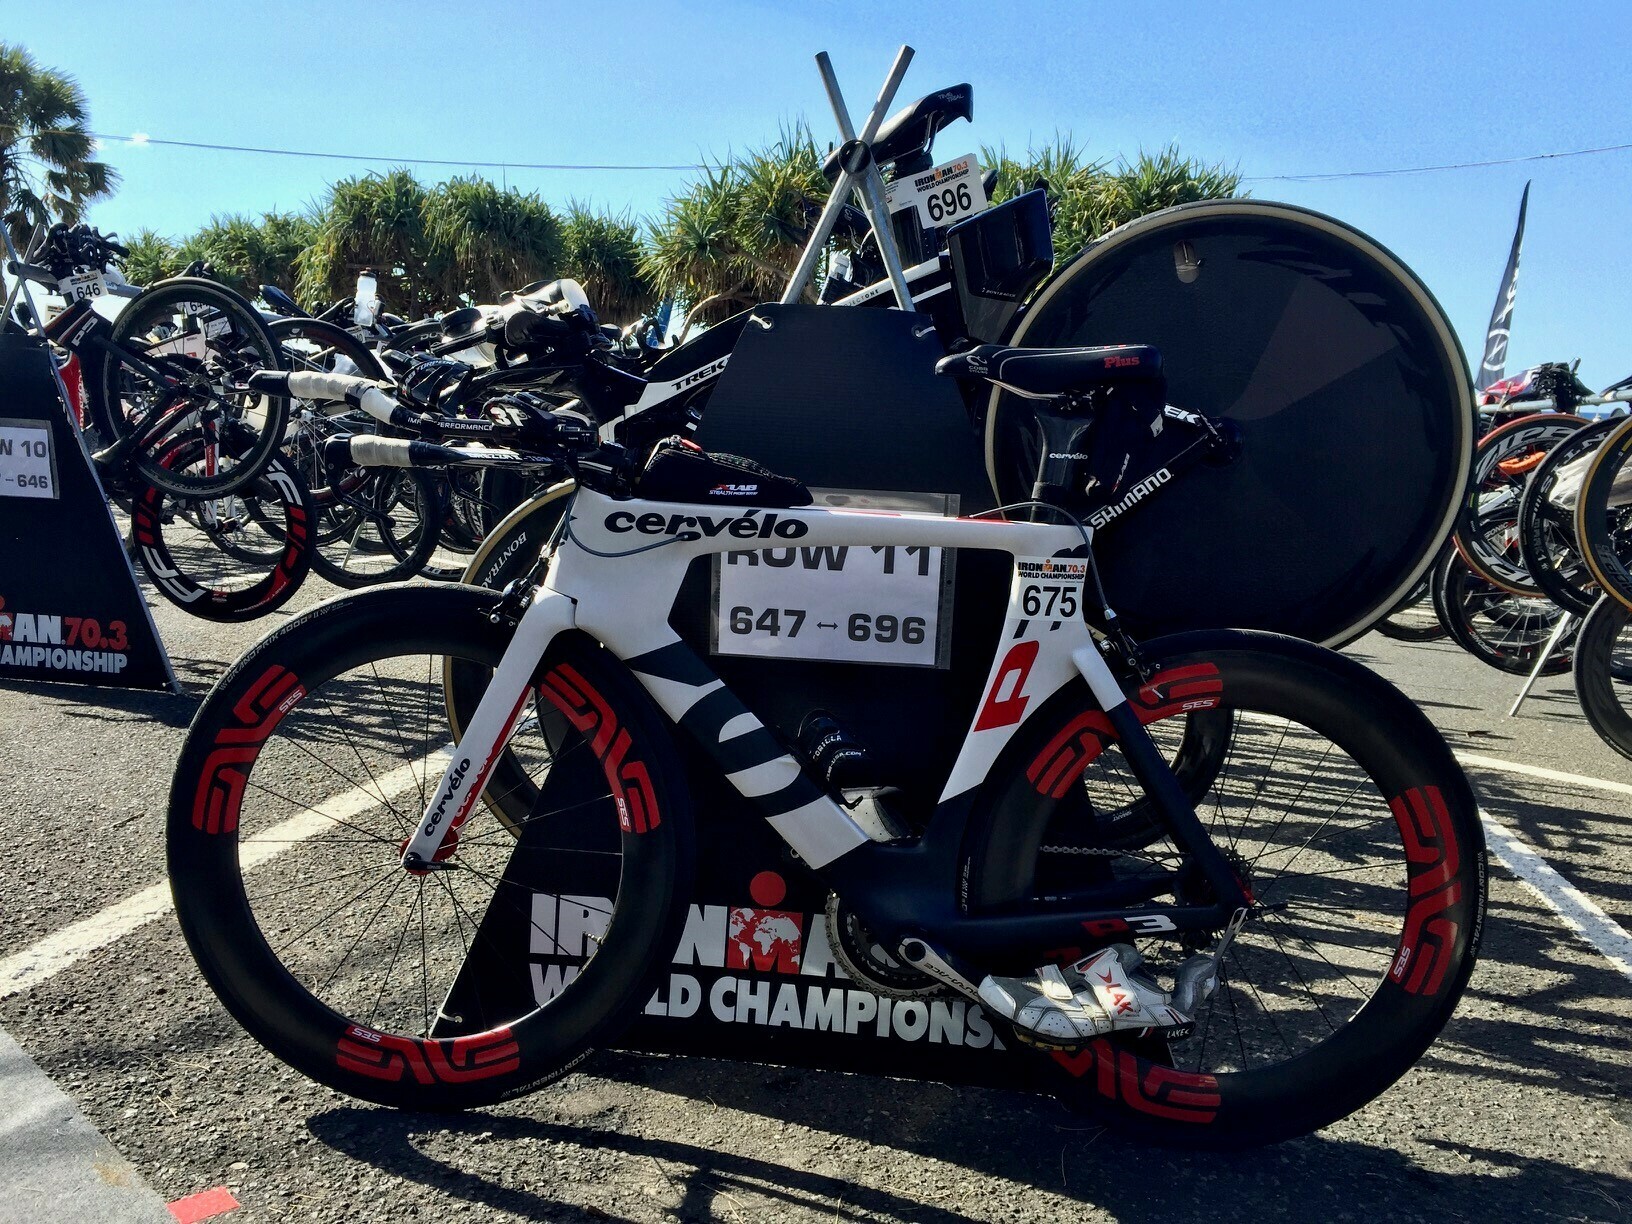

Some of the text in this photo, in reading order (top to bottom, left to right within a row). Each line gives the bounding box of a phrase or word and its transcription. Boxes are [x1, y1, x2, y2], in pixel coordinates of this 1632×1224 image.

[927, 182, 972, 222] 696
[76, 282, 101, 299] 646
[671, 357, 729, 391] TREK
[1104, 356, 1140, 368] Plus
[490, 405, 524, 427] 3T
[1163, 404, 1201, 424] EK
[21, 440, 47, 458] 10
[1048, 451, 1089, 460] cervélo
[17, 474, 48, 489] 646
[1090, 467, 1172, 530] SHIMANO
[604, 509, 808, 541] cervélo
[870, 545, 929, 576] 11
[1017, 560, 1086, 574] IRONMAN 70.3
[1017, 570, 1085, 580] WORLD CHAMPIONSHIP
[1022, 584, 1078, 618] 675
[729, 605, 926, 645] 647 696
[278, 689, 304, 714] SES
[1181, 699, 1216, 712] SES
[424, 757, 472, 838] cervélo
[616, 797, 631, 828] SES
[1393, 945, 1411, 979] SES
[708, 976, 1007, 1052] CHAMPIONS
[351, 1027, 382, 1044] SES
